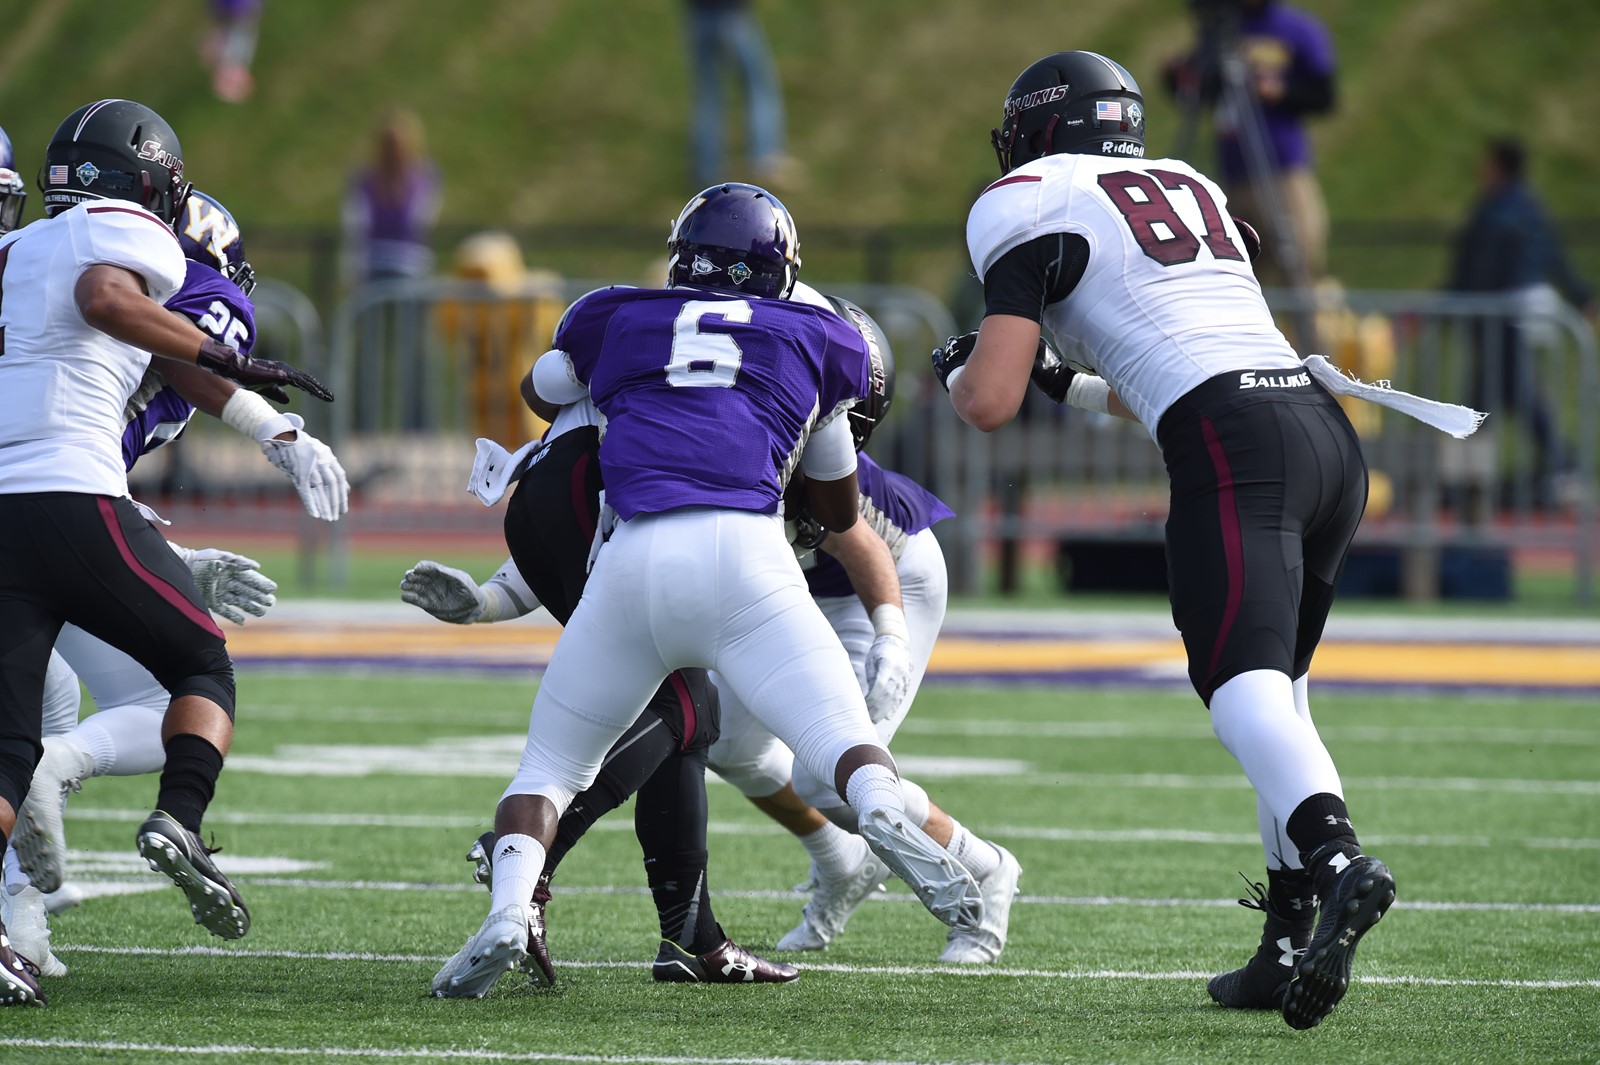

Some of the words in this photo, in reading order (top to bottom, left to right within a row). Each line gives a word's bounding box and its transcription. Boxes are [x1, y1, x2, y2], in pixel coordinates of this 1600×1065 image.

[1102, 141, 1145, 157] Riddell
[1097, 169, 1245, 267] 87
[664, 300, 753, 389] 6
[1239, 370, 1311, 389] SALUKIS
